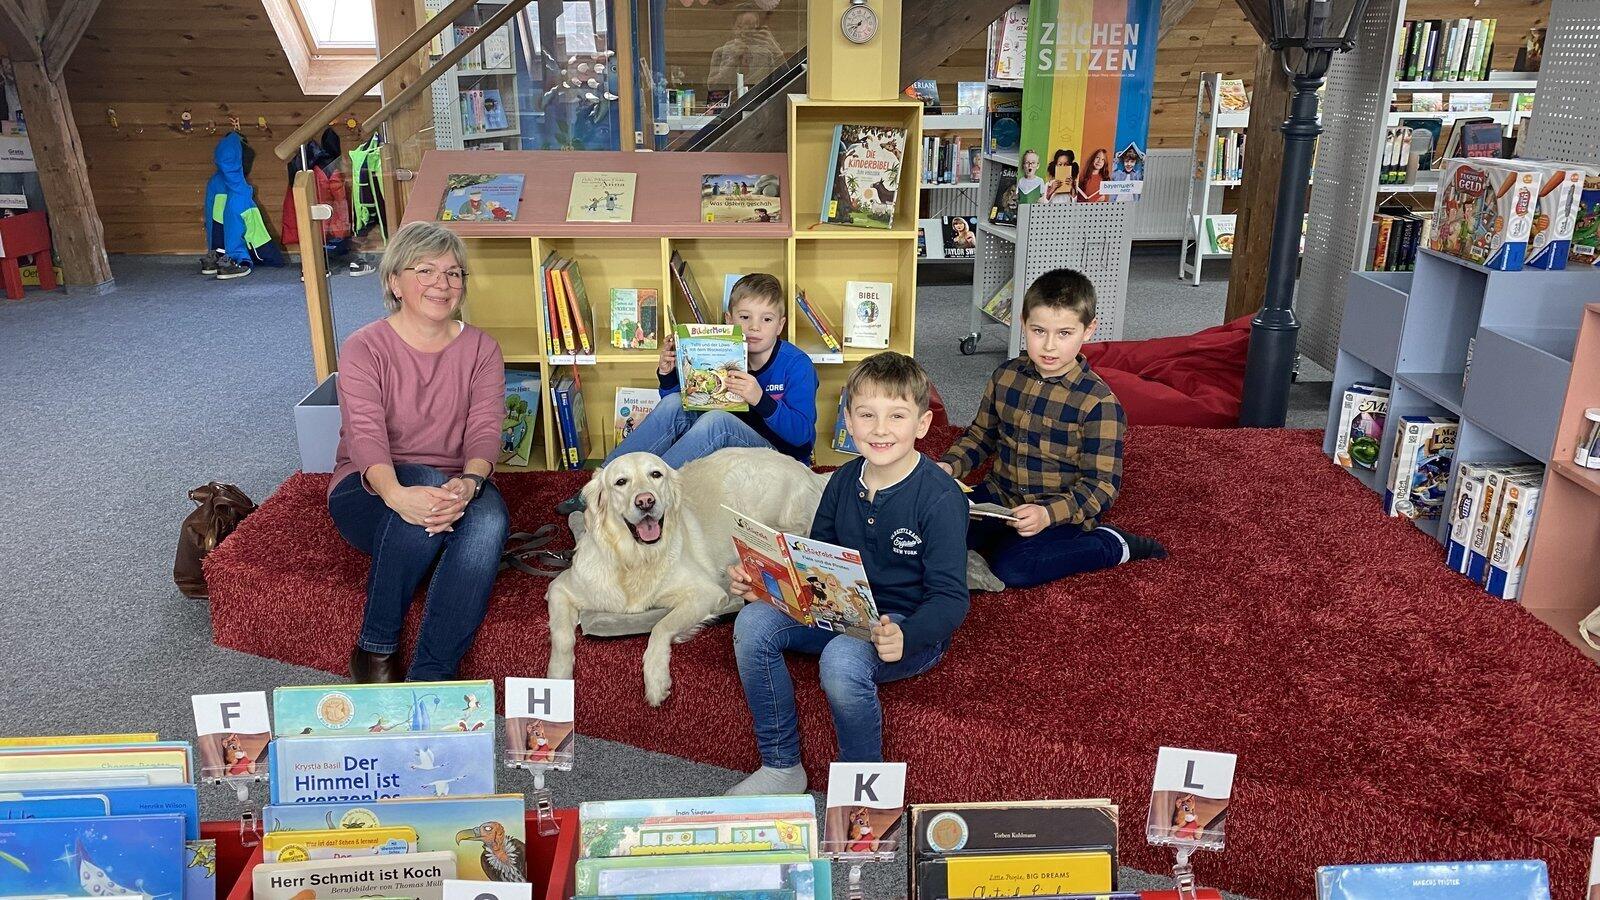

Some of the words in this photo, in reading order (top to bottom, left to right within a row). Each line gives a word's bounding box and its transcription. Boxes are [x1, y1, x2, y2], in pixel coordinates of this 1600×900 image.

[1040, 23, 1140, 46] ZEICHEN
[1038, 48, 1137, 71] SETZEN
[1459, 180, 1482, 192] GELD
[765, 384, 785, 392] CORE
[528, 687, 551, 715] H
[220, 702, 241, 729] F
[344, 756, 379, 771] Der
[1183, 760, 1204, 790] L
[295, 773, 369, 791] Himmel
[376, 773, 400, 789] ist
[854, 773, 881, 801] K
[271, 876, 305, 889] Herr
[310, 871, 375, 886] Schmidt
[379, 869, 399, 881] ist
[403, 866, 441, 879] Koch
[331, 885, 377, 894] Berufsbilder
